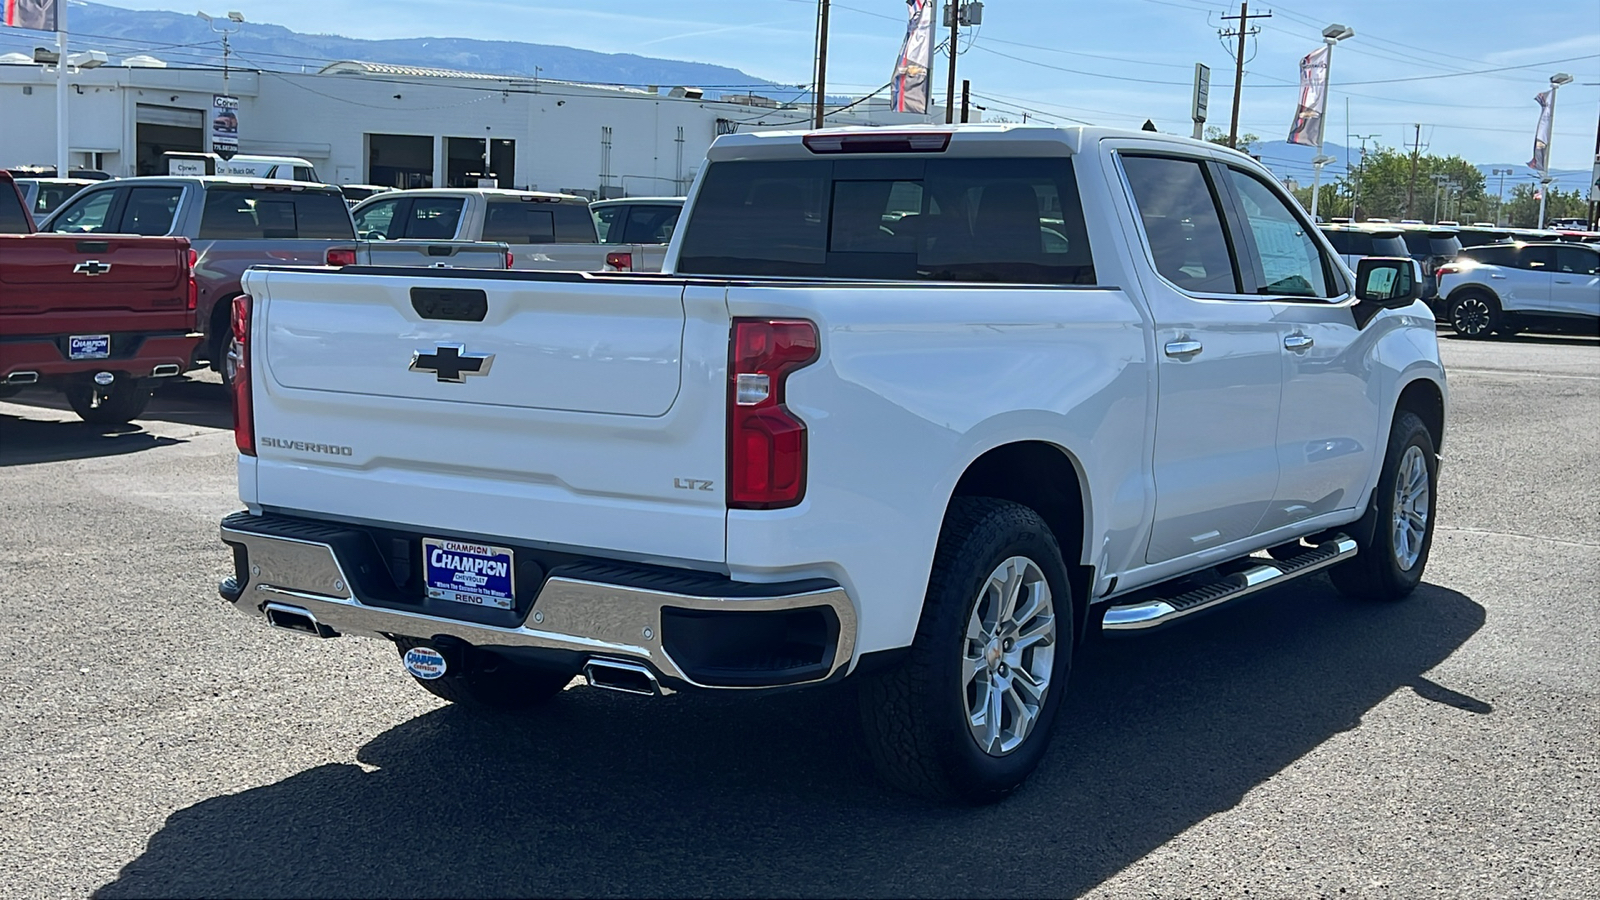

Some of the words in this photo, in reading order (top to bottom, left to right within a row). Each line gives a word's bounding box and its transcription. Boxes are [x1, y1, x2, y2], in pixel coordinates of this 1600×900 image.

[216, 98, 238, 108] Corwin
[261, 437, 352, 456] SILVERADO
[674, 478, 714, 491] LTZ
[446, 542, 488, 555] CHAMPION
[431, 548, 507, 578] CHAMPION
[455, 573, 485, 584] CHEVROLET
[455, 594, 483, 604] RENO
